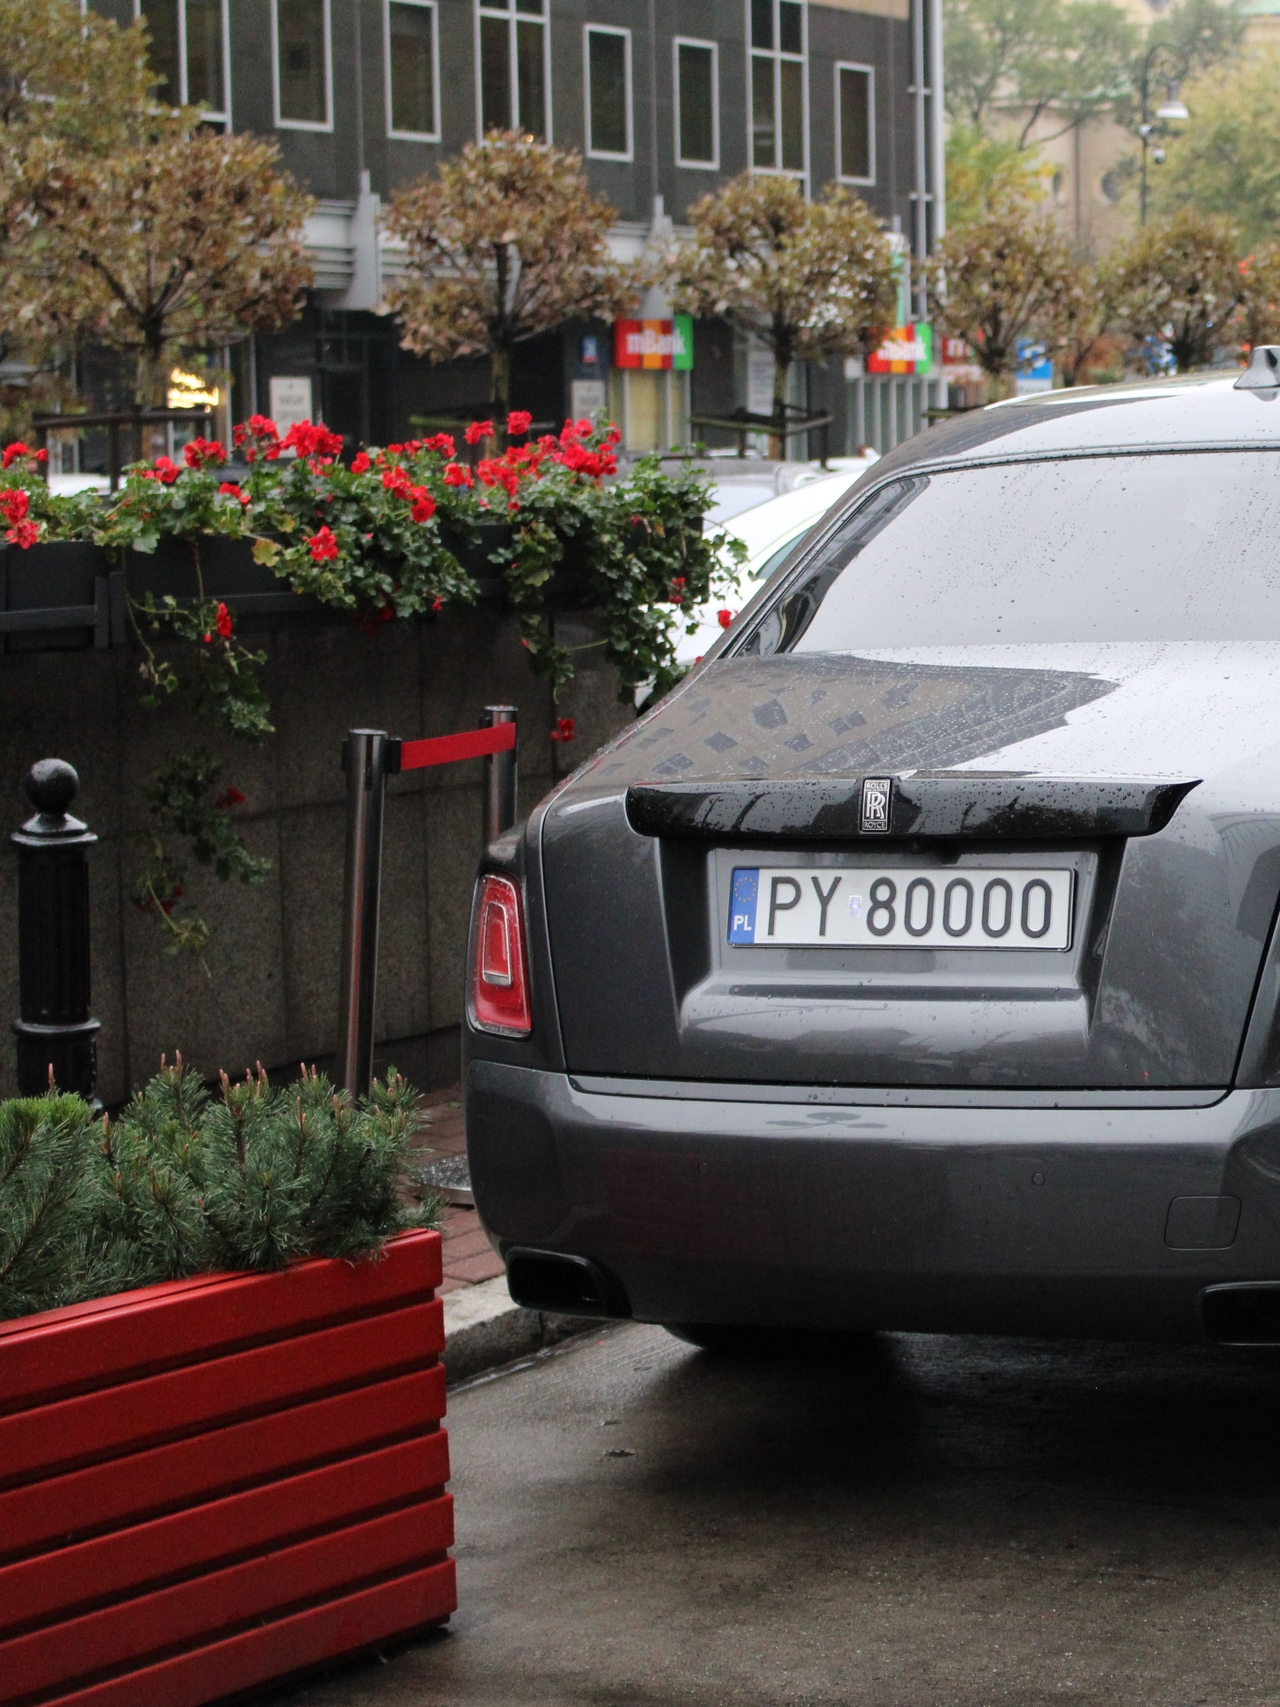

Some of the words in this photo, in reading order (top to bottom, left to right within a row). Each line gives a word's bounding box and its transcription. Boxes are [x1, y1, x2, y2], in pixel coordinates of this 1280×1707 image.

[626, 328, 687, 354] mBank
[864, 821, 886, 829] ROYCE
[767, 875, 842, 937] PY
[866, 876, 1053, 939] 80000
[733, 915, 752, 931] PL
